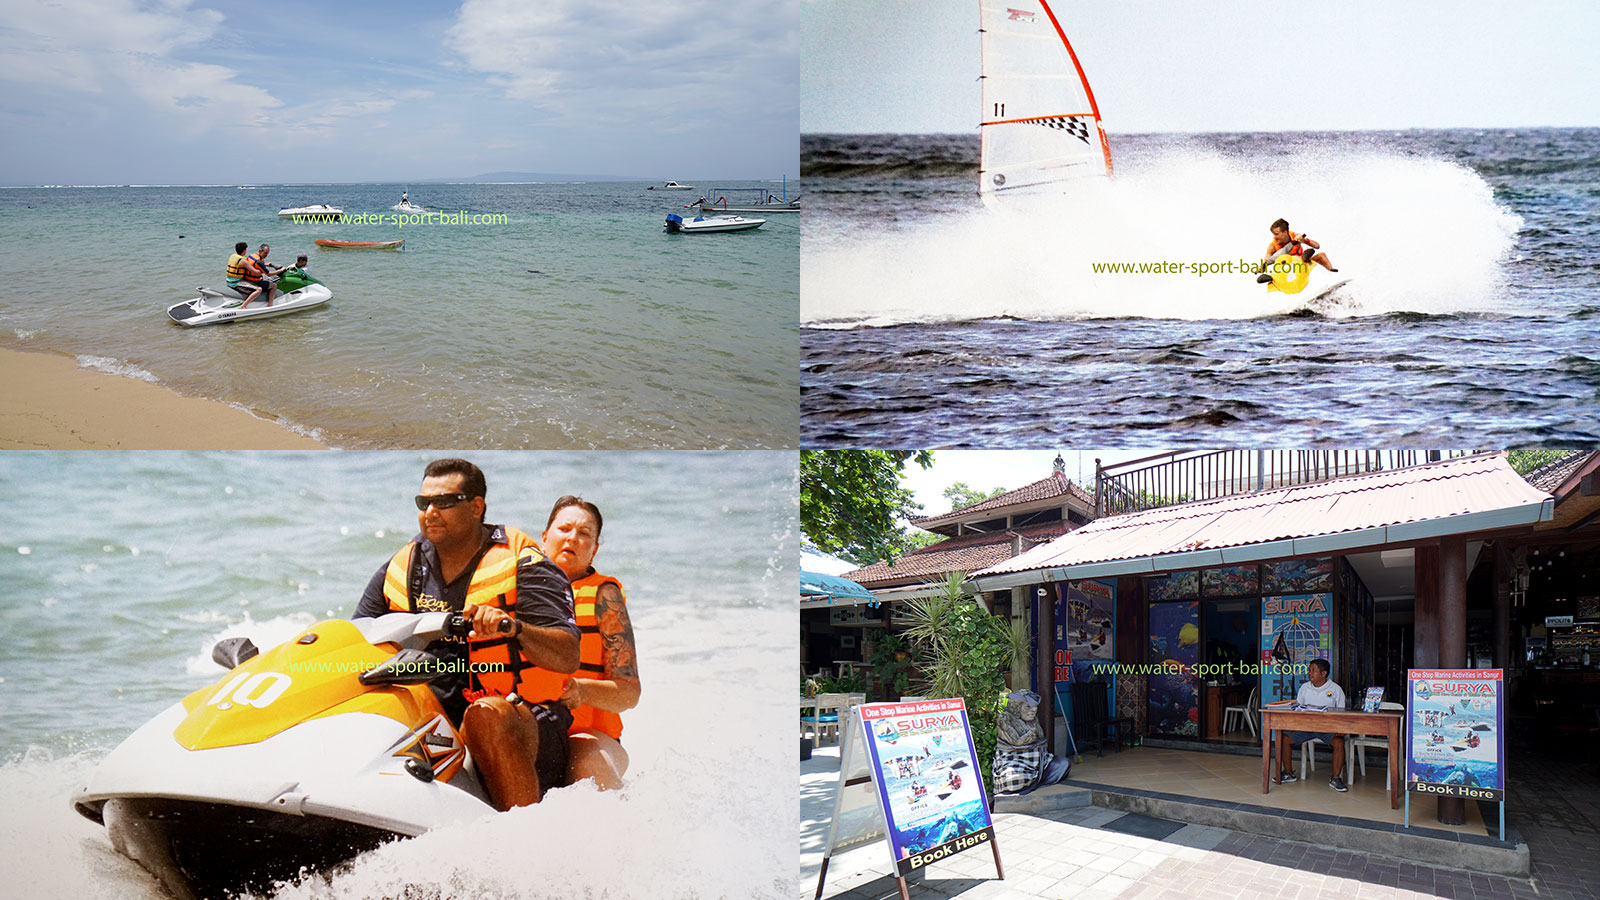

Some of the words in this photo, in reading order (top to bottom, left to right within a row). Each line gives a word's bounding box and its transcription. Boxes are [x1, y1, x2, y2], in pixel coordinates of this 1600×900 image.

[994, 102, 1005, 117] 11
[1265, 598, 1326, 614] SURYA
[1056, 649, 1073, 665] OK
[1055, 666, 1069, 682] RE
[1422, 671, 1433, 679] Stop
[1482, 671, 1500, 679] Sanur
[207, 672, 292, 708] 10
[1432, 683, 1493, 693] SURYA
[865, 708, 880, 717] One
[880, 706, 896, 717] Stop
[896, 705, 916, 714] Marine
[916, 703, 940, 712] Activities
[896, 714, 960, 732] SURYA
[1416, 783, 1454, 795] Book
[1458, 787, 1494, 799] Here
[910, 844, 953, 870] Book
[955, 832, 988, 851] Here
